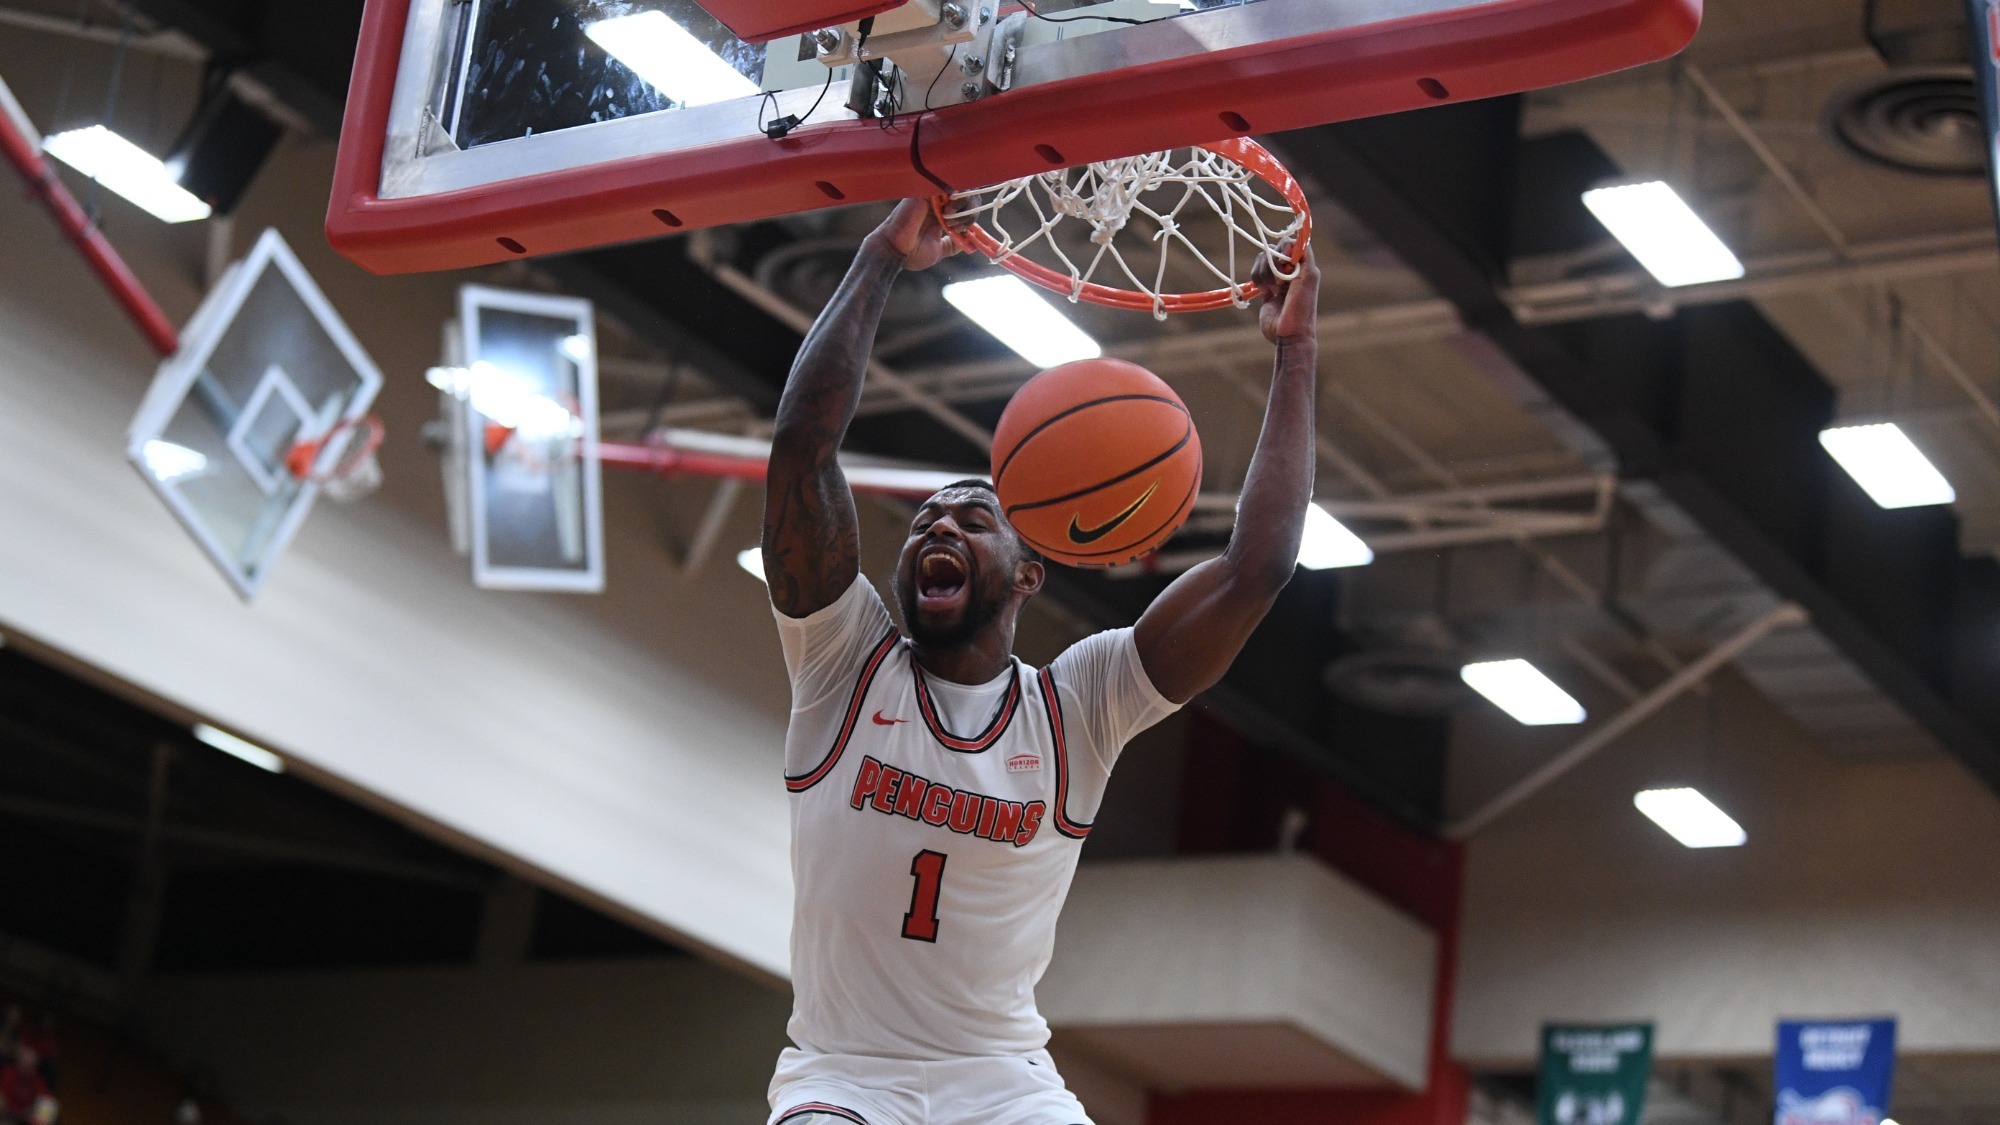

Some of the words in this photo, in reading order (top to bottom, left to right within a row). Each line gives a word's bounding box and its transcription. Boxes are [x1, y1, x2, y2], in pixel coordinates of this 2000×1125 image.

[851, 755, 1046, 848] PENGUINS
[1009, 759, 1040, 767] HORIZON
[901, 848, 947, 943] 1
